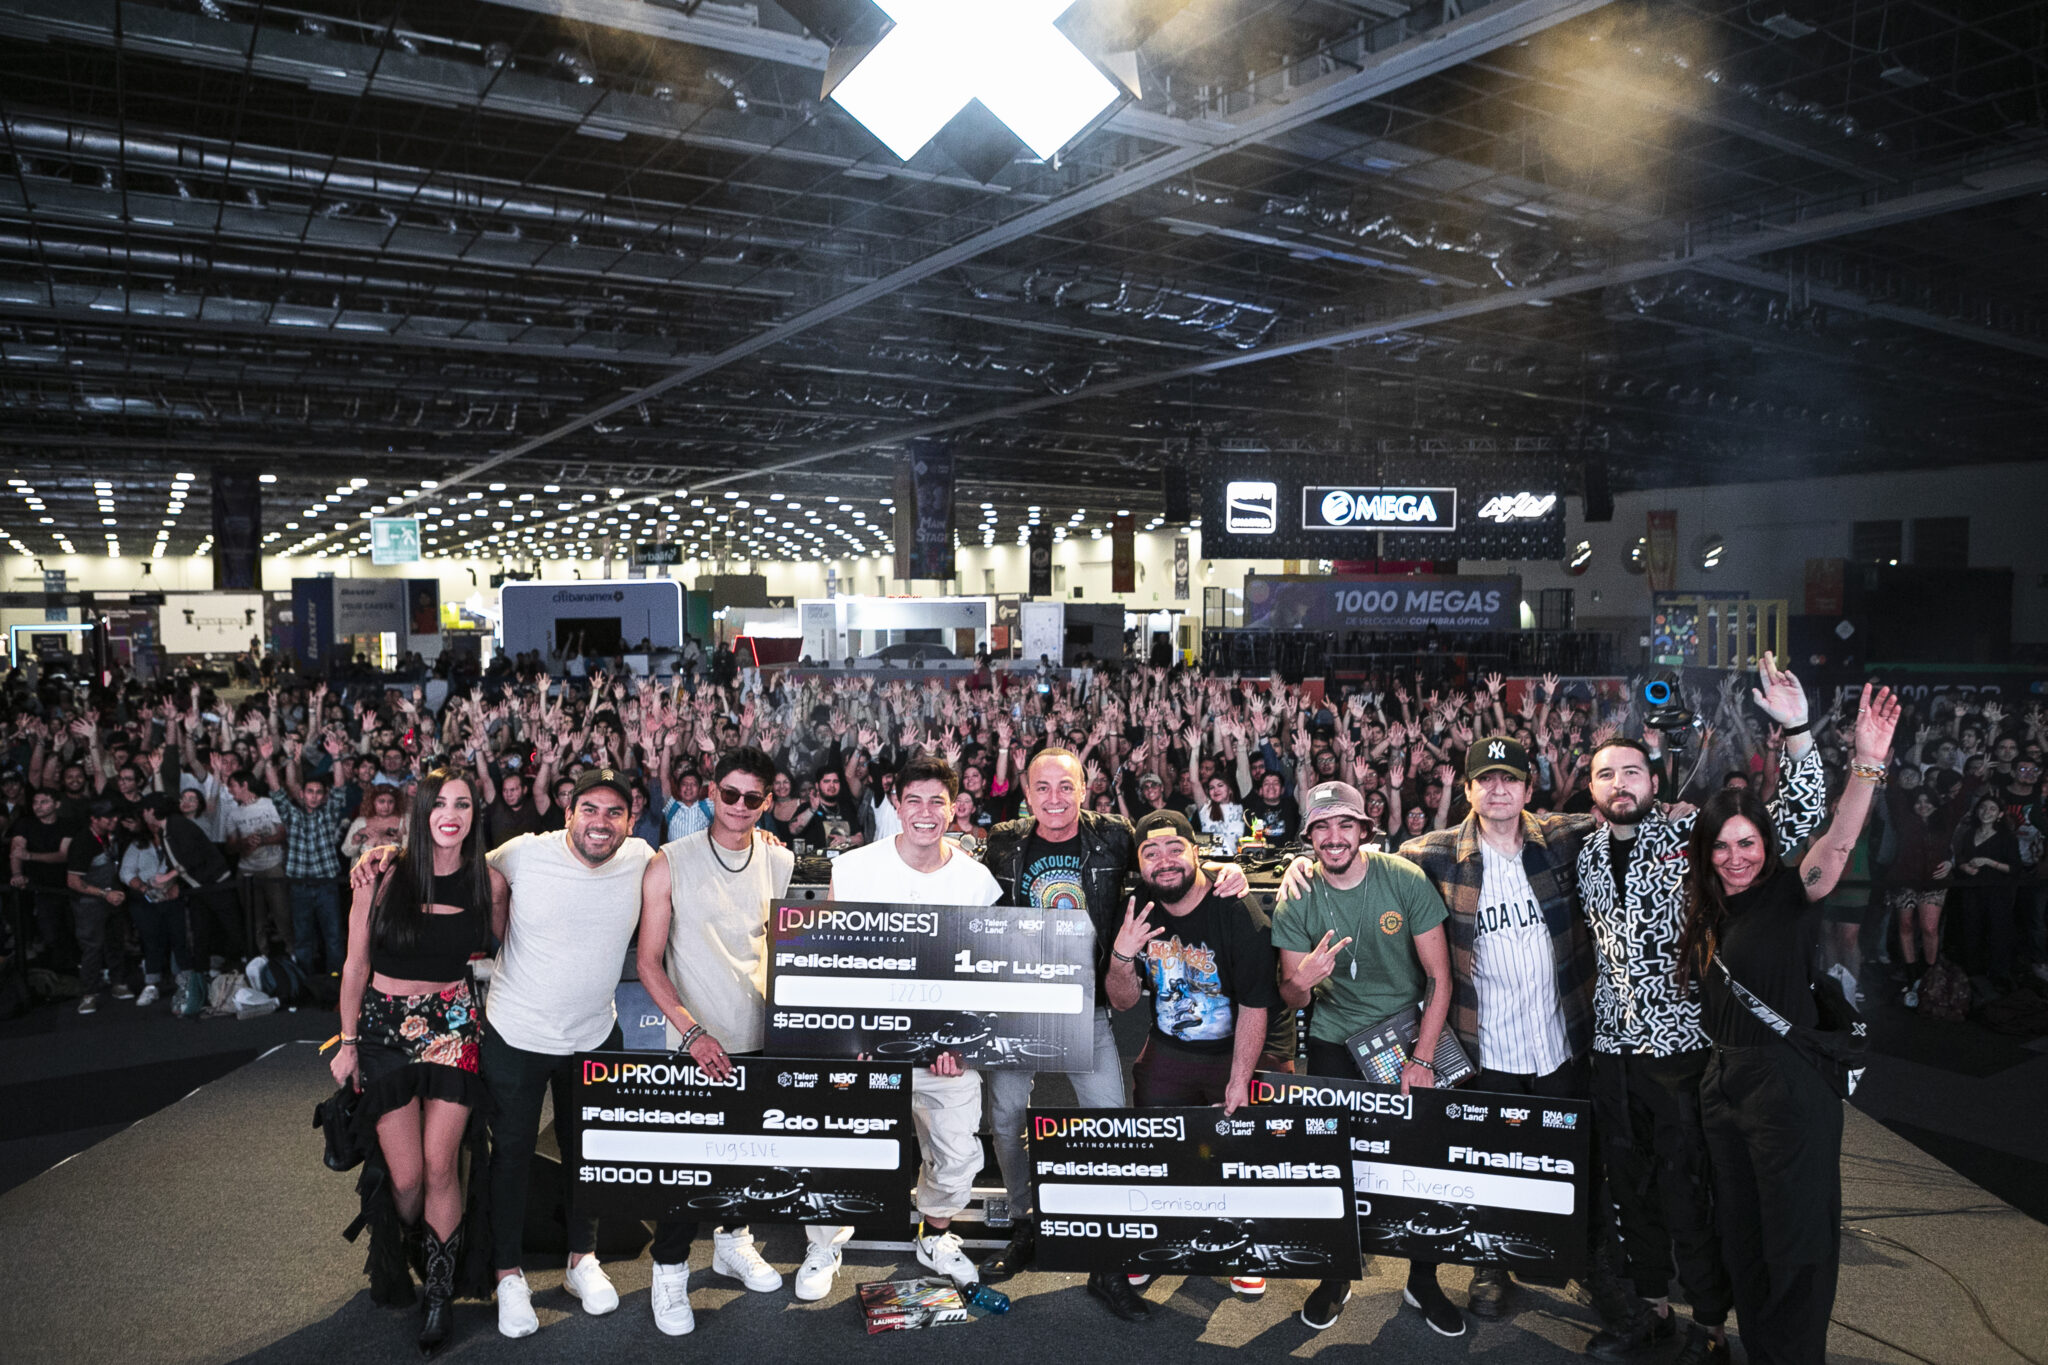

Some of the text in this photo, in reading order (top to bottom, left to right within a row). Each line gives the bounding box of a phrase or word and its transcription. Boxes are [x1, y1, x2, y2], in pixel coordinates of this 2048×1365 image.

[1334, 590, 1501, 613] 1000 MEGAS
[1488, 741, 1506, 759] NY
[984, 919, 1008, 927] Talent
[811, 934, 905, 943] LATINOAMERICA
[954, 950, 1082, 979] 1er Lugar
[773, 1012, 912, 1031] $2000 USD
[793, 1072, 819, 1081] Talent
[794, 1080, 814, 1088] Land
[616, 1088, 712, 1097] LATINOAMERICA
[1462, 1104, 1488, 1114] Talent
[1463, 1113, 1484, 1122] Land
[1542, 1110, 1563, 1120] DNA
[762, 1109, 898, 1134] 2do Lugar
[1230, 1120, 1255, 1128] Talent
[1305, 1118, 1324, 1126] DNA
[1232, 1127, 1252, 1136] Land
[1448, 1145, 1575, 1175] Finalista
[579, 1165, 712, 1186] $1000 USD
[1222, 1162, 1341, 1179] Finalista
[1402, 1169, 1475, 1199] Riveros
[1040, 1219, 1158, 1239] $500 USD
